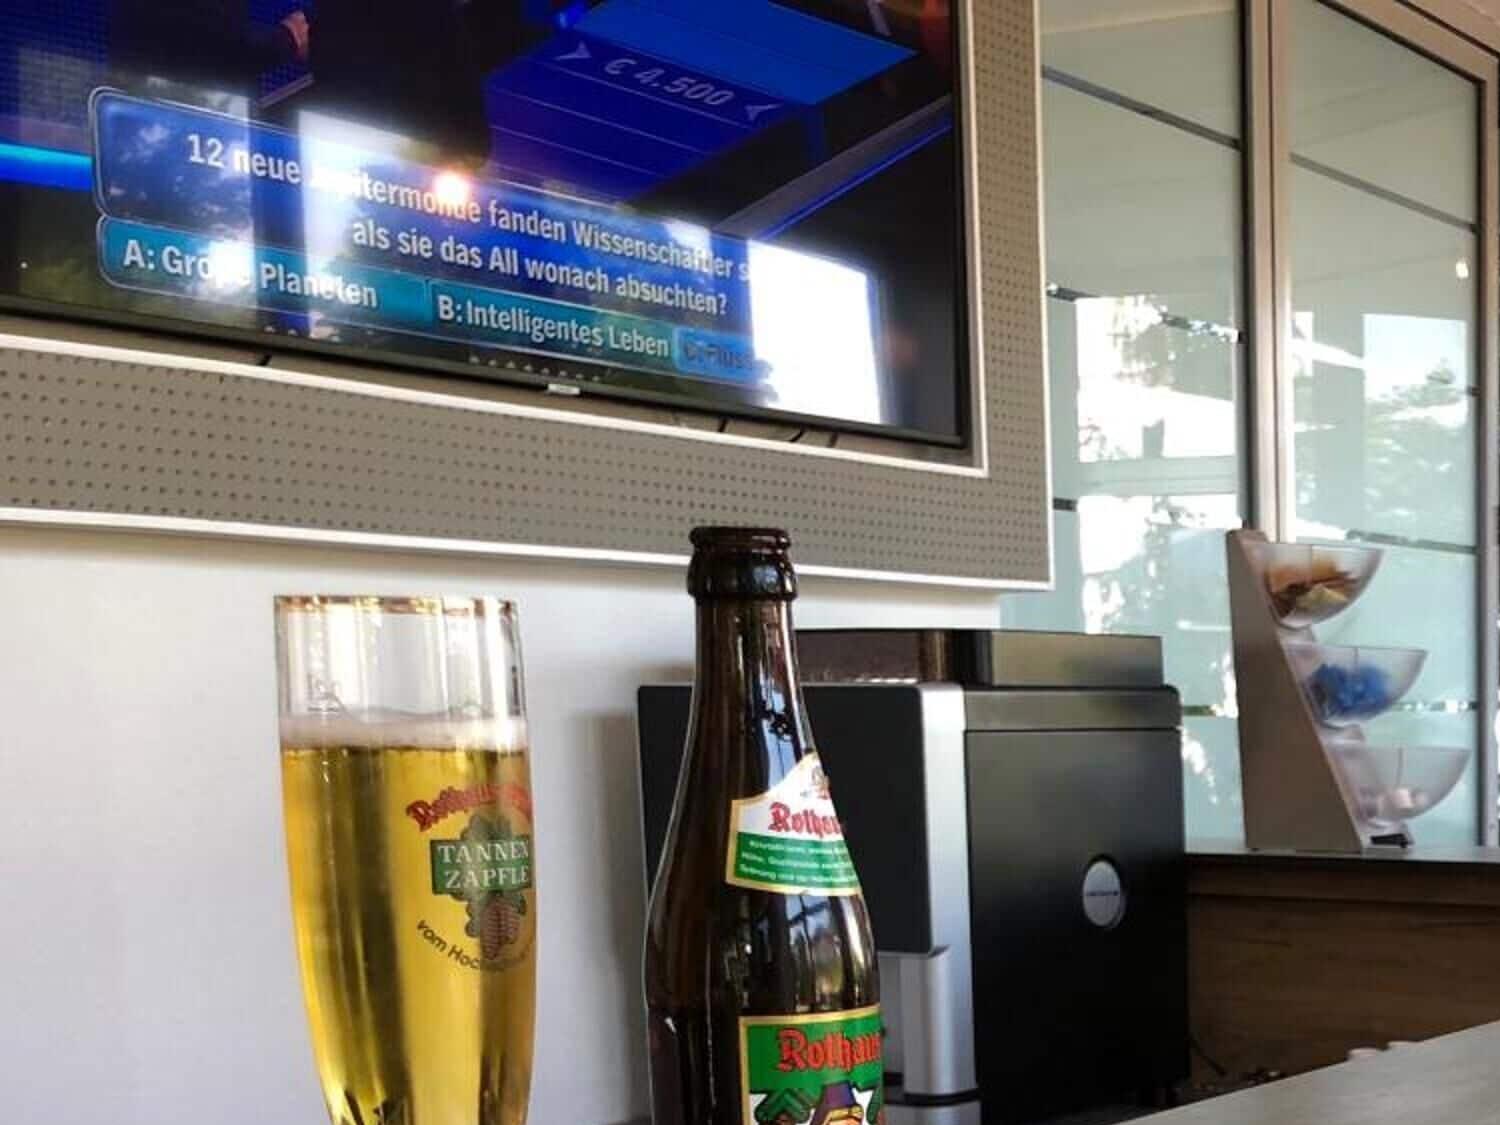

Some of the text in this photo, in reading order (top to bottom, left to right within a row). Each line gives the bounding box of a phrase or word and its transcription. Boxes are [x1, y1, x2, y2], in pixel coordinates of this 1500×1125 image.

[634, 67, 735, 105] 4.500
[186, 134, 224, 167] 12
[233, 146, 300, 183] neue
[489, 200, 566, 241] fanden
[572, 221, 733, 276] Wissenschaftler
[123, 240, 154, 271] A:
[261, 264, 377, 308] Planeten
[353, 220, 727, 316] als sie das All wonach absuchten?
[608, 326, 670, 358] Leben
[417, 919, 448, 953] vom
